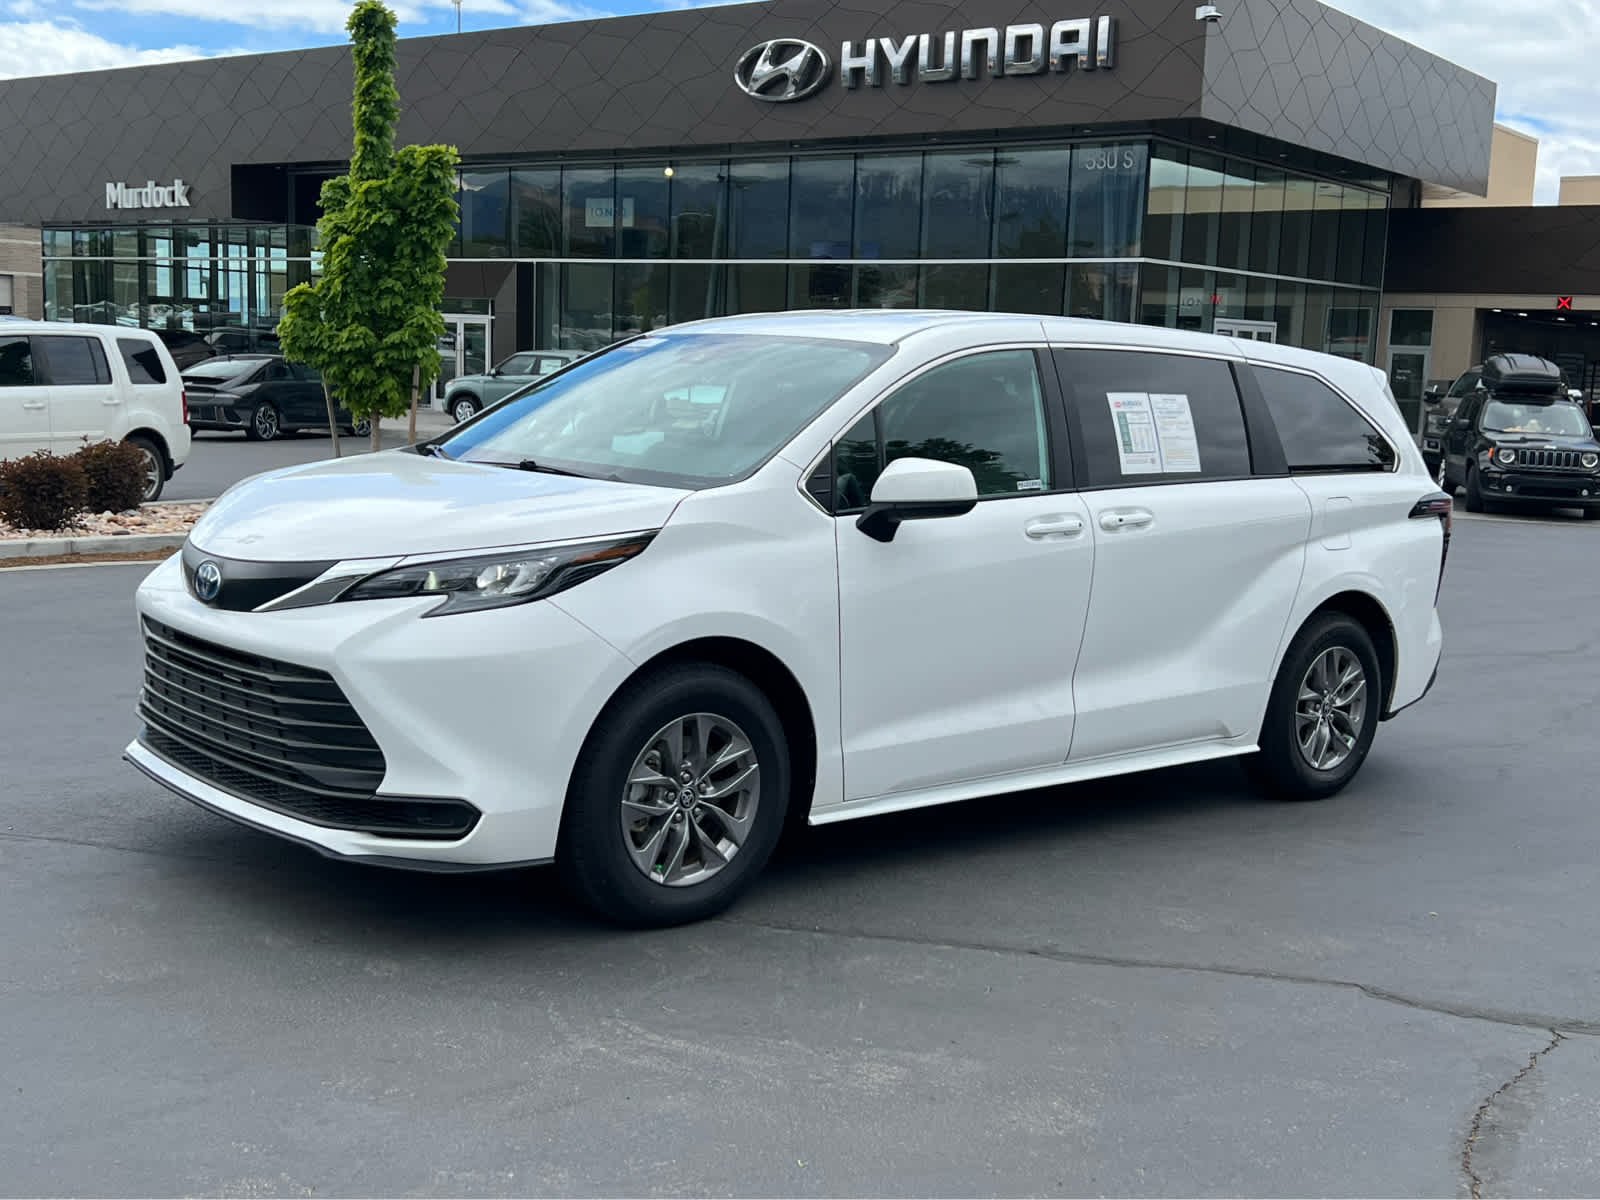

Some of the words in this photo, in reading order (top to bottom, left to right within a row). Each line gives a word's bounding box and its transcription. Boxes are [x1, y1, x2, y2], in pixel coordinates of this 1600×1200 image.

[840, 15, 1114, 89] HYUNDAI
[1123, 150, 1133, 168] S
[105, 178, 191, 209] Murdock
